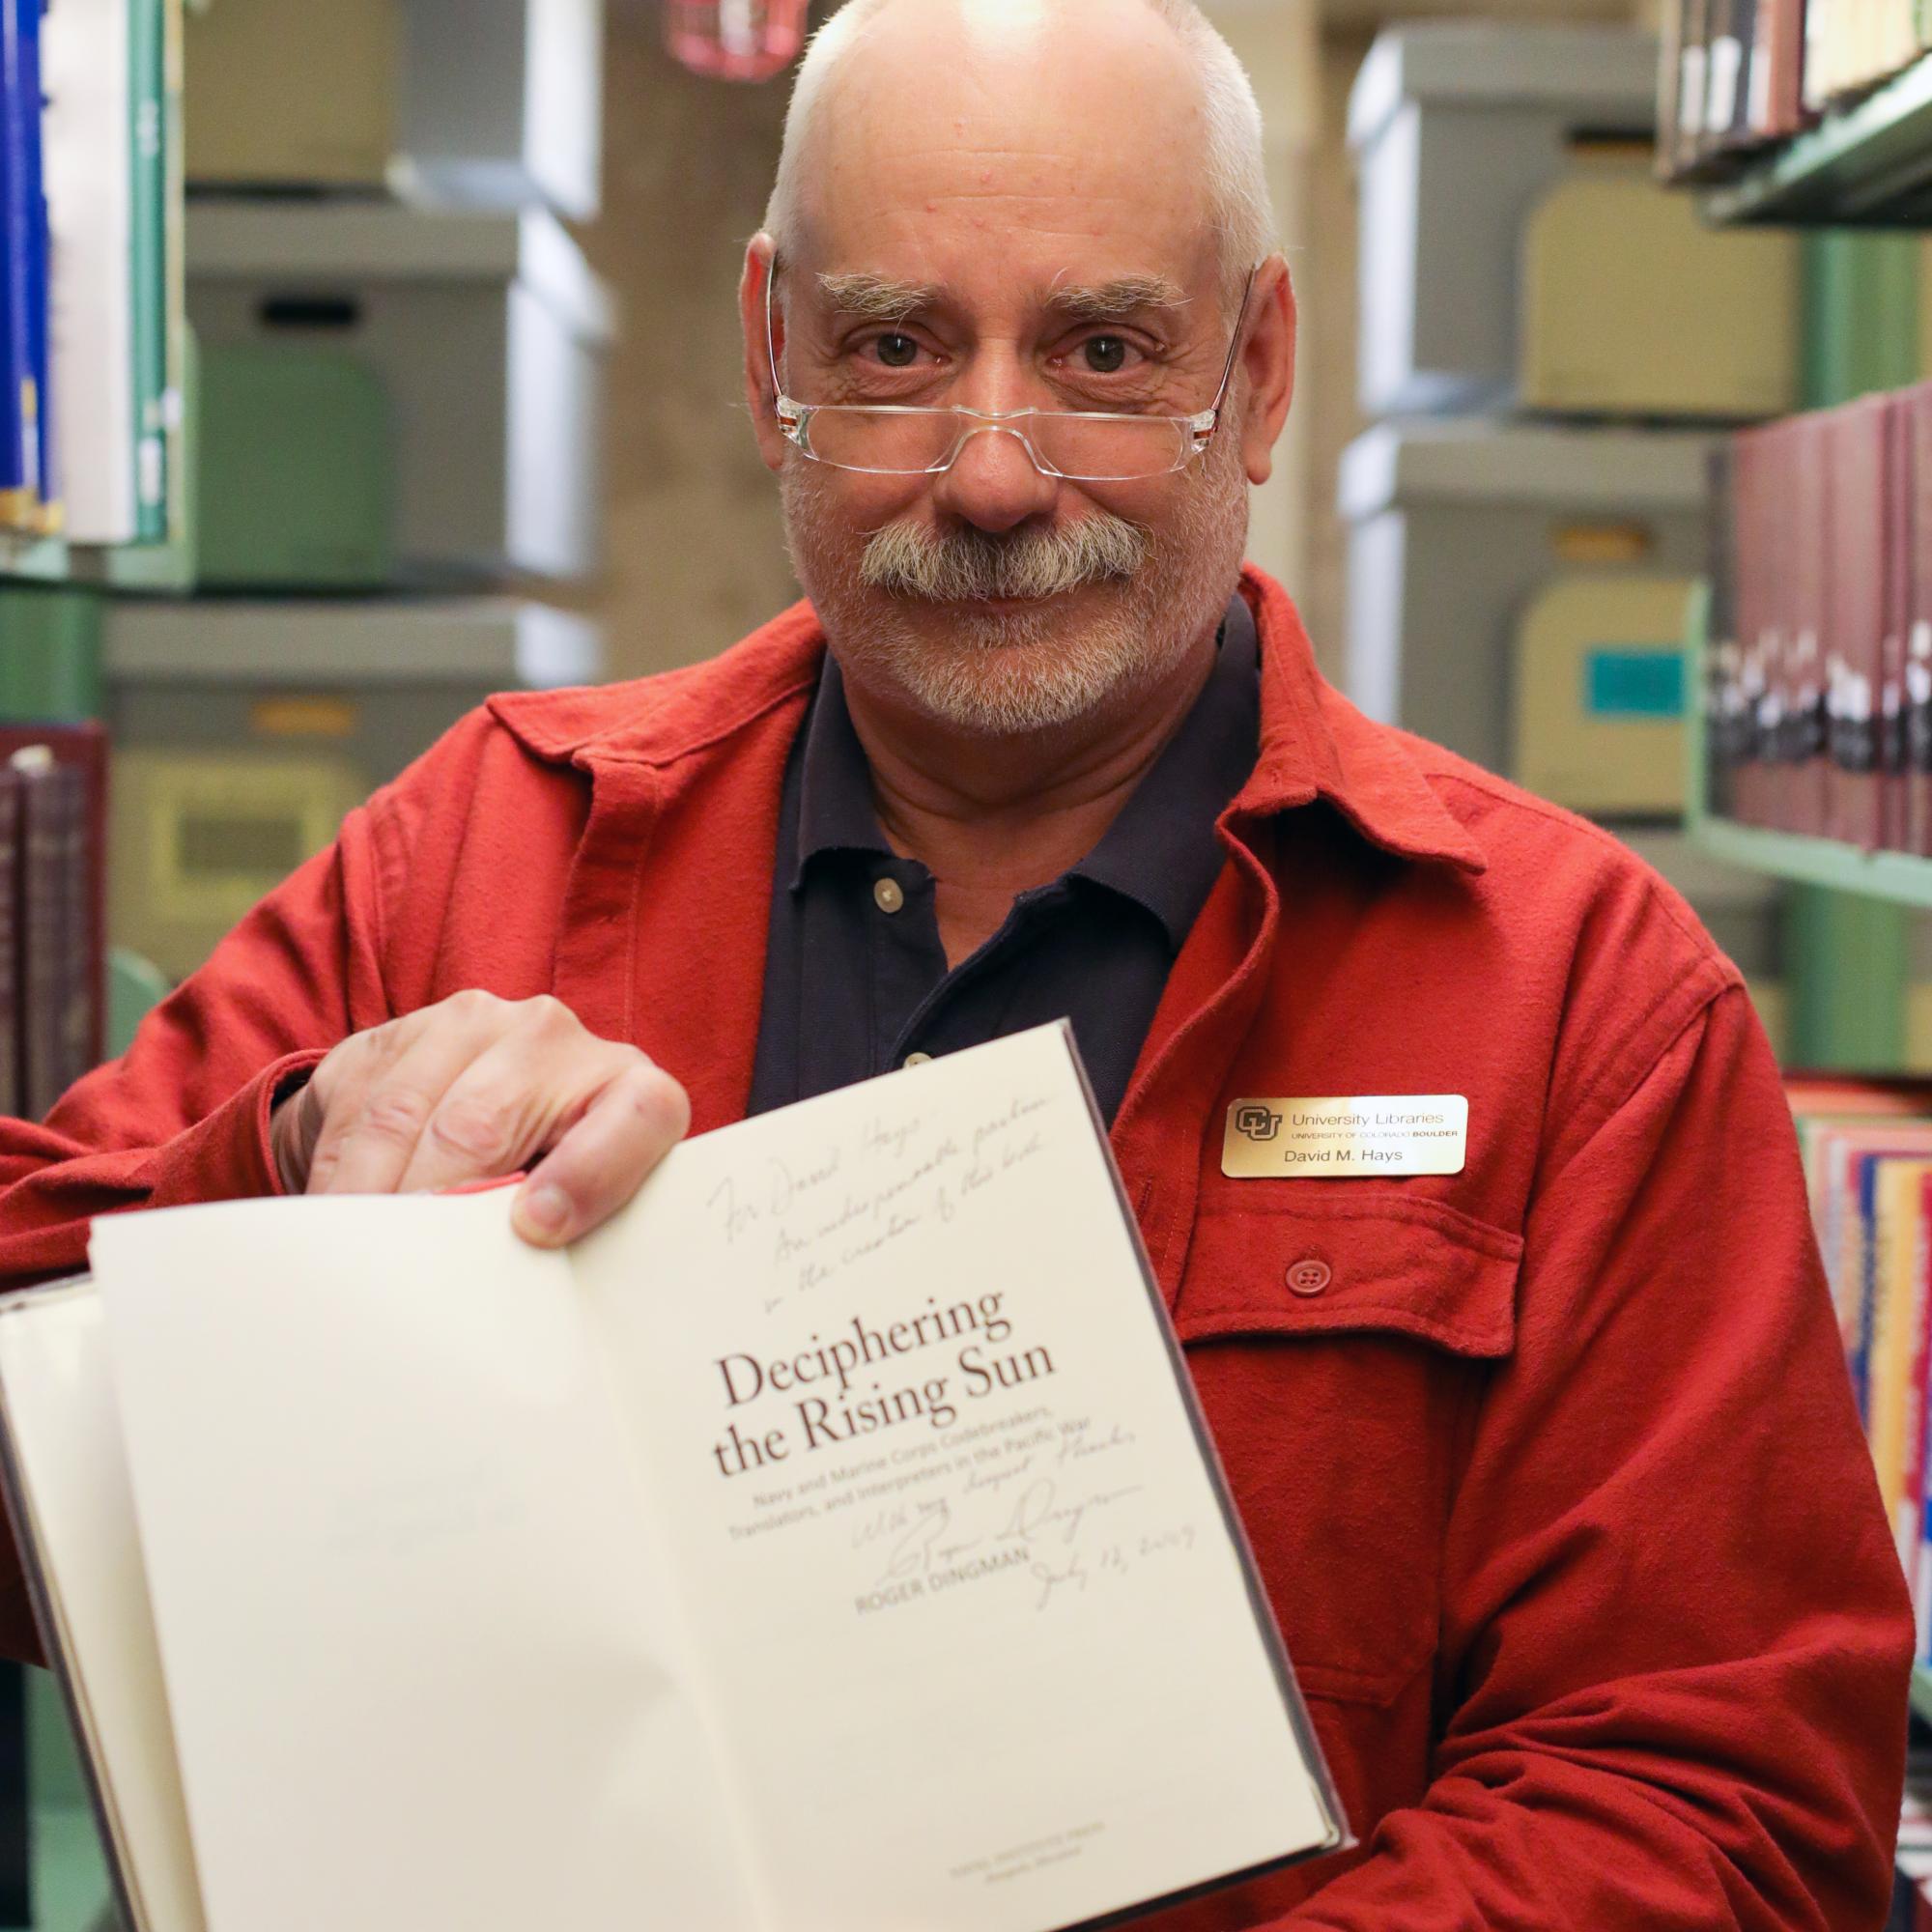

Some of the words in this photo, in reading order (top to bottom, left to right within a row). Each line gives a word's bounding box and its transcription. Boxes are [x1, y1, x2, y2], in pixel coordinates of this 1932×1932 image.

[1292, 1113, 1371, 1128] University
[1376, 1112, 1445, 1125] Libraries
[1292, 1132, 1344, 1141] UNIVERSITY
[1346, 1131, 1358, 1140] OF
[1360, 1130, 1411, 1139] COLORADO
[765, 1145, 840, 1217] David
[1285, 1150, 1331, 1163] David
[1336, 1150, 1355, 1162] M.
[1361, 1149, 1403, 1164] Hays
[797, 1263, 837, 1293] the
[715, 1291, 1011, 1408] Deciphering
[714, 1422, 790, 1478] the
[795, 1378, 957, 1450] Rising
[958, 1345, 1056, 1399] Sun
[753, 1488, 793, 1508] Navy
[798, 1475, 826, 1494] and
[830, 1457, 887, 1484] Marine
[891, 1441, 937, 1464] Corps
[824, 1490, 854, 1512] and
[954, 1456, 971, 1469] in
[972, 1445, 1001, 1463] the
[1004, 1427, 1054, 1452] Pacific
[1059, 1416, 1091, 1435] War
[855, 1577, 924, 1616] ROGER
[928, 1546, 1030, 1592] DINGMAN
